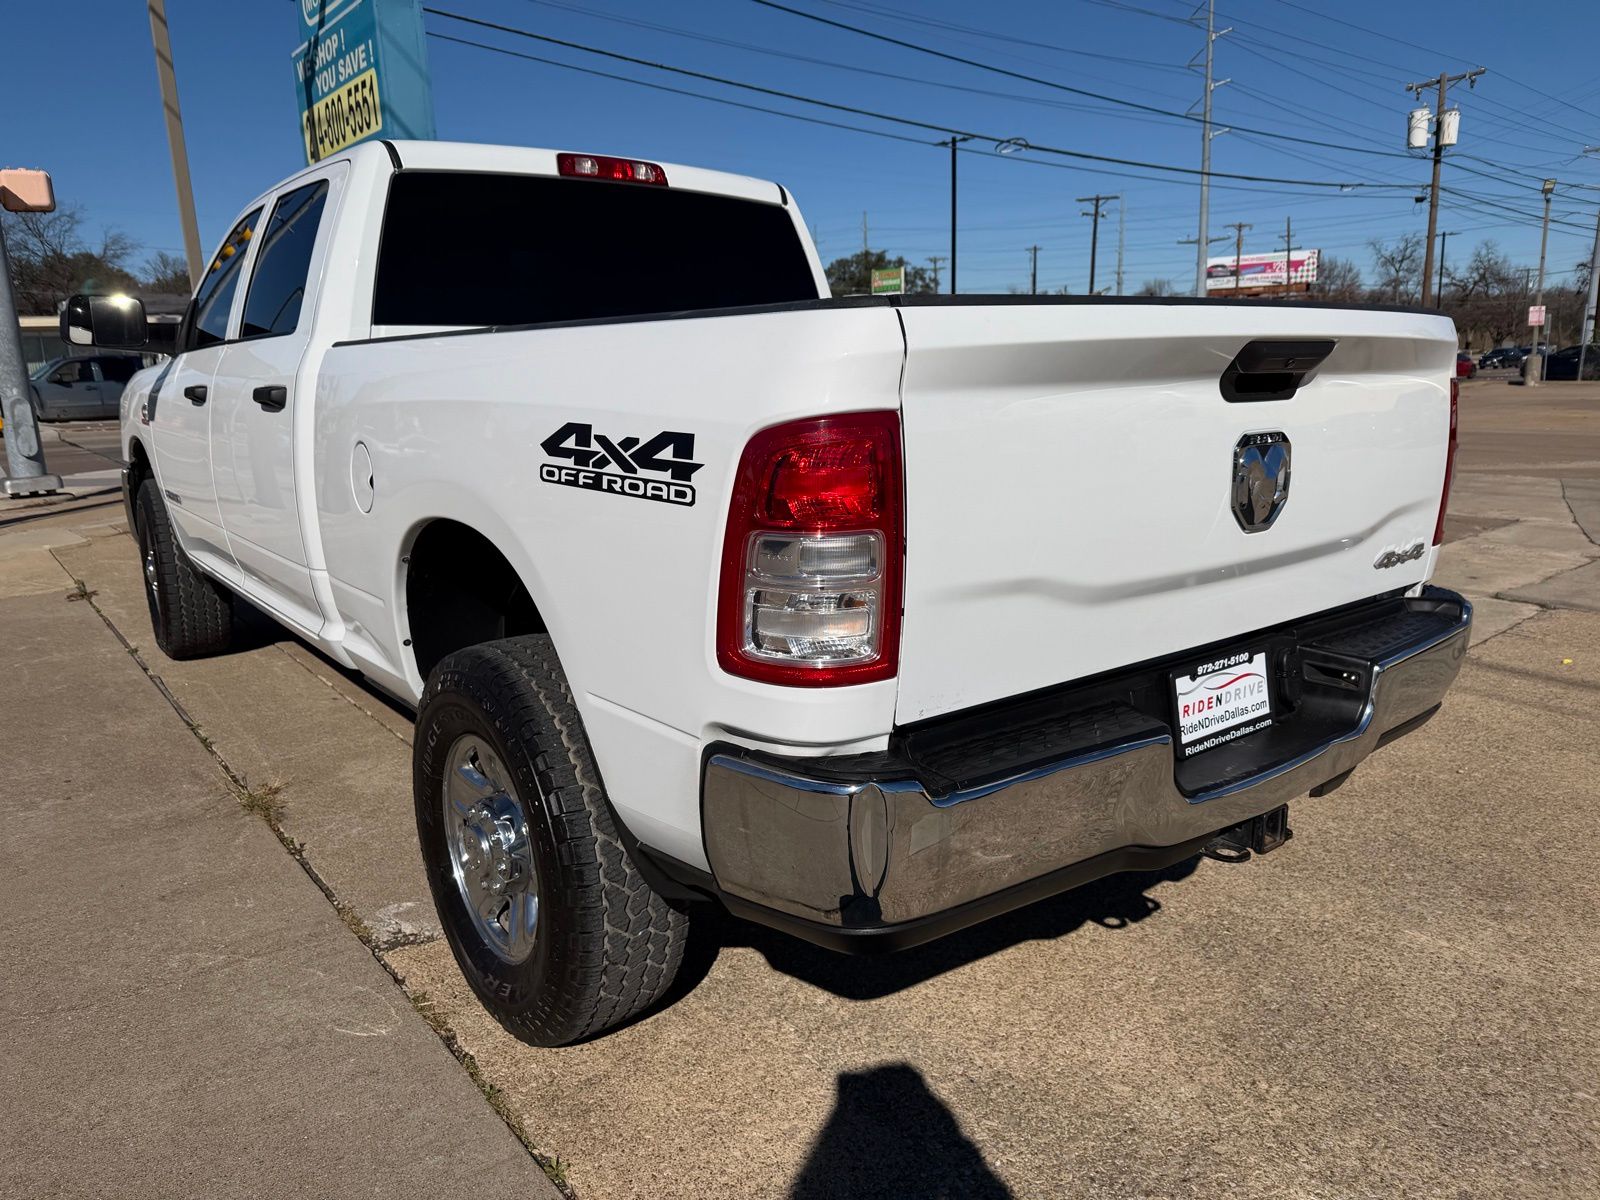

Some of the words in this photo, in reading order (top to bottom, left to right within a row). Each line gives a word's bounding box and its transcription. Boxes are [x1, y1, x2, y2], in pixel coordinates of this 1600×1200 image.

[296, 55, 312, 82] WE
[312, 33, 339, 71] SHOP
[315, 64, 336, 96] YOU
[338, 44, 368, 82] SAVE
[542, 466, 596, 486] OFF
[602, 475, 693, 504] ROAD
[1197, 652, 1249, 675] 972-271-5100
[1180, 699, 1268, 736] RideNDriveDallas.com
[1185, 718, 1273, 756] RideNDriveDallas.com
